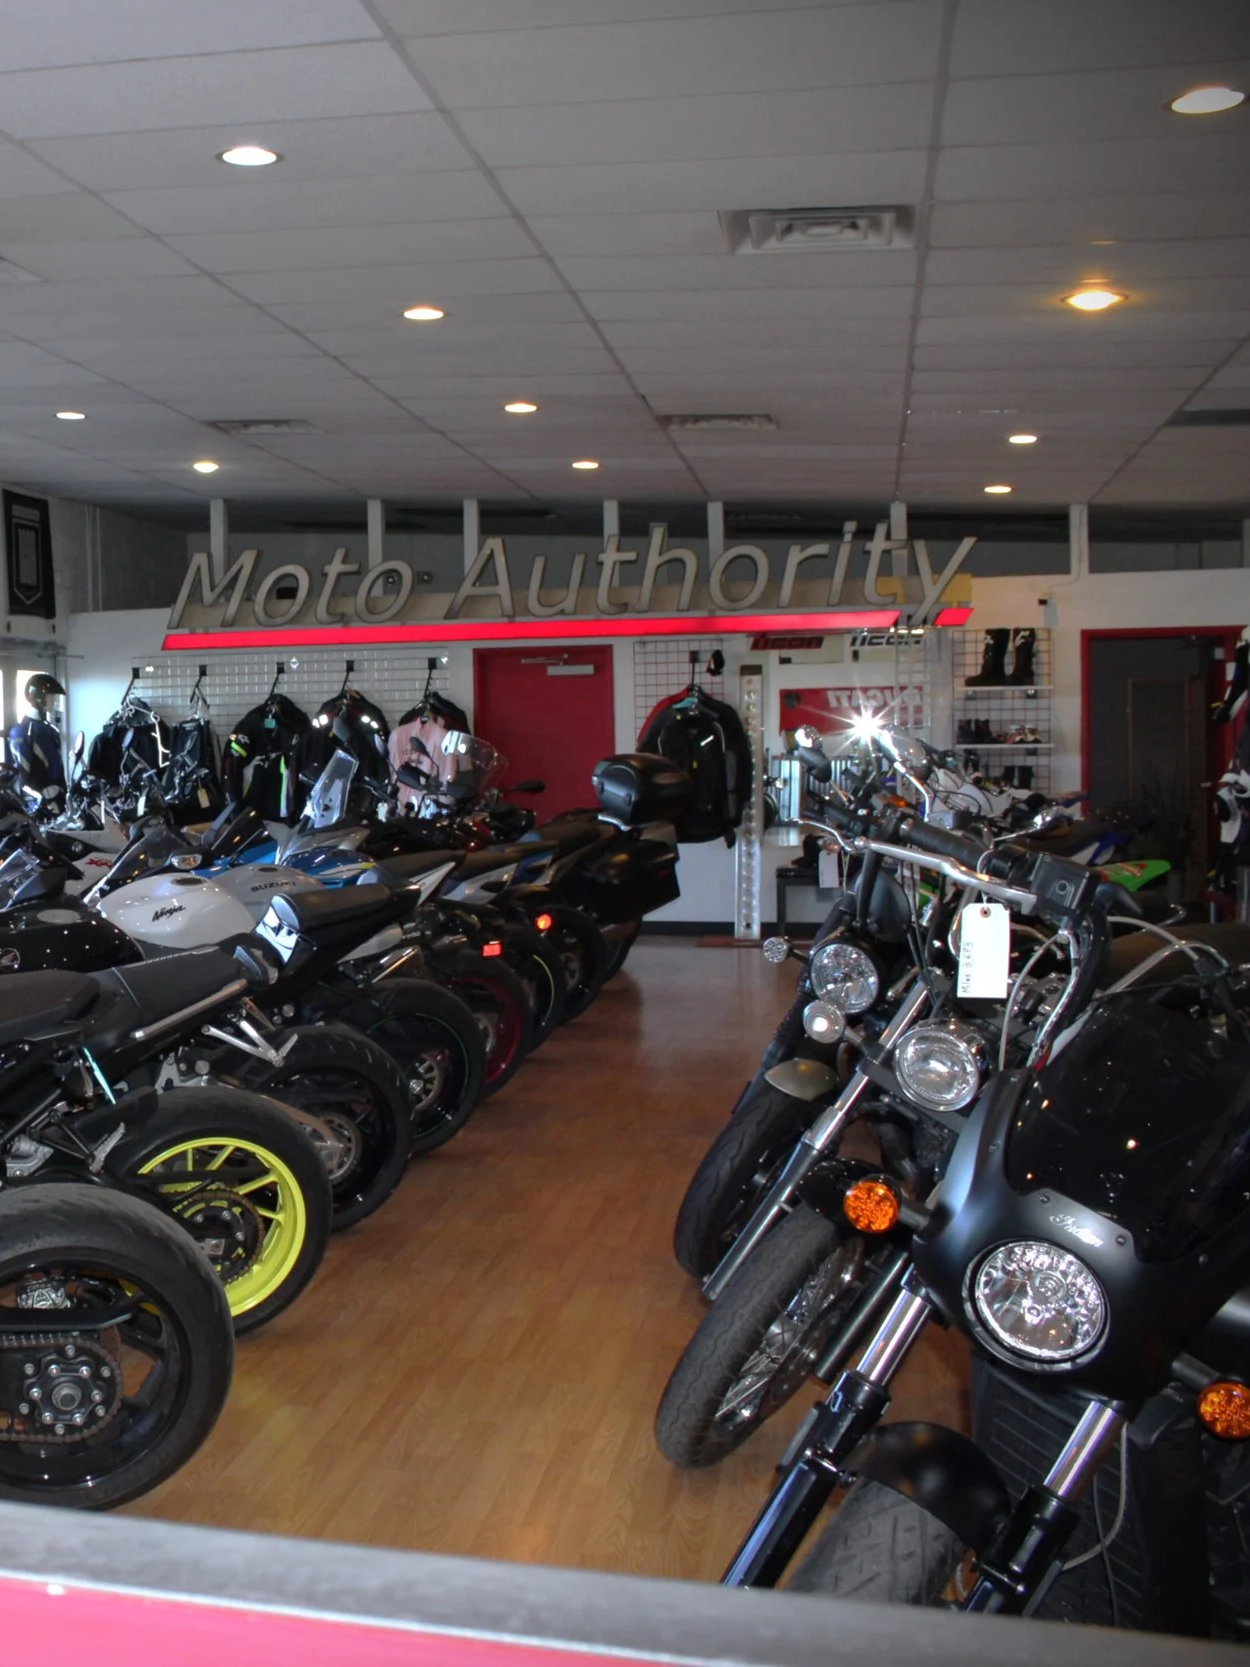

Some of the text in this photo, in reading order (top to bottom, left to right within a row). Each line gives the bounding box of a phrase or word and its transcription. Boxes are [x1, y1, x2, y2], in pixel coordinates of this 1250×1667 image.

[167, 520, 978, 629] Moto Authority
[251, 880, 296, 892] SUZUKI
[152, 905, 186, 922] Ninja
